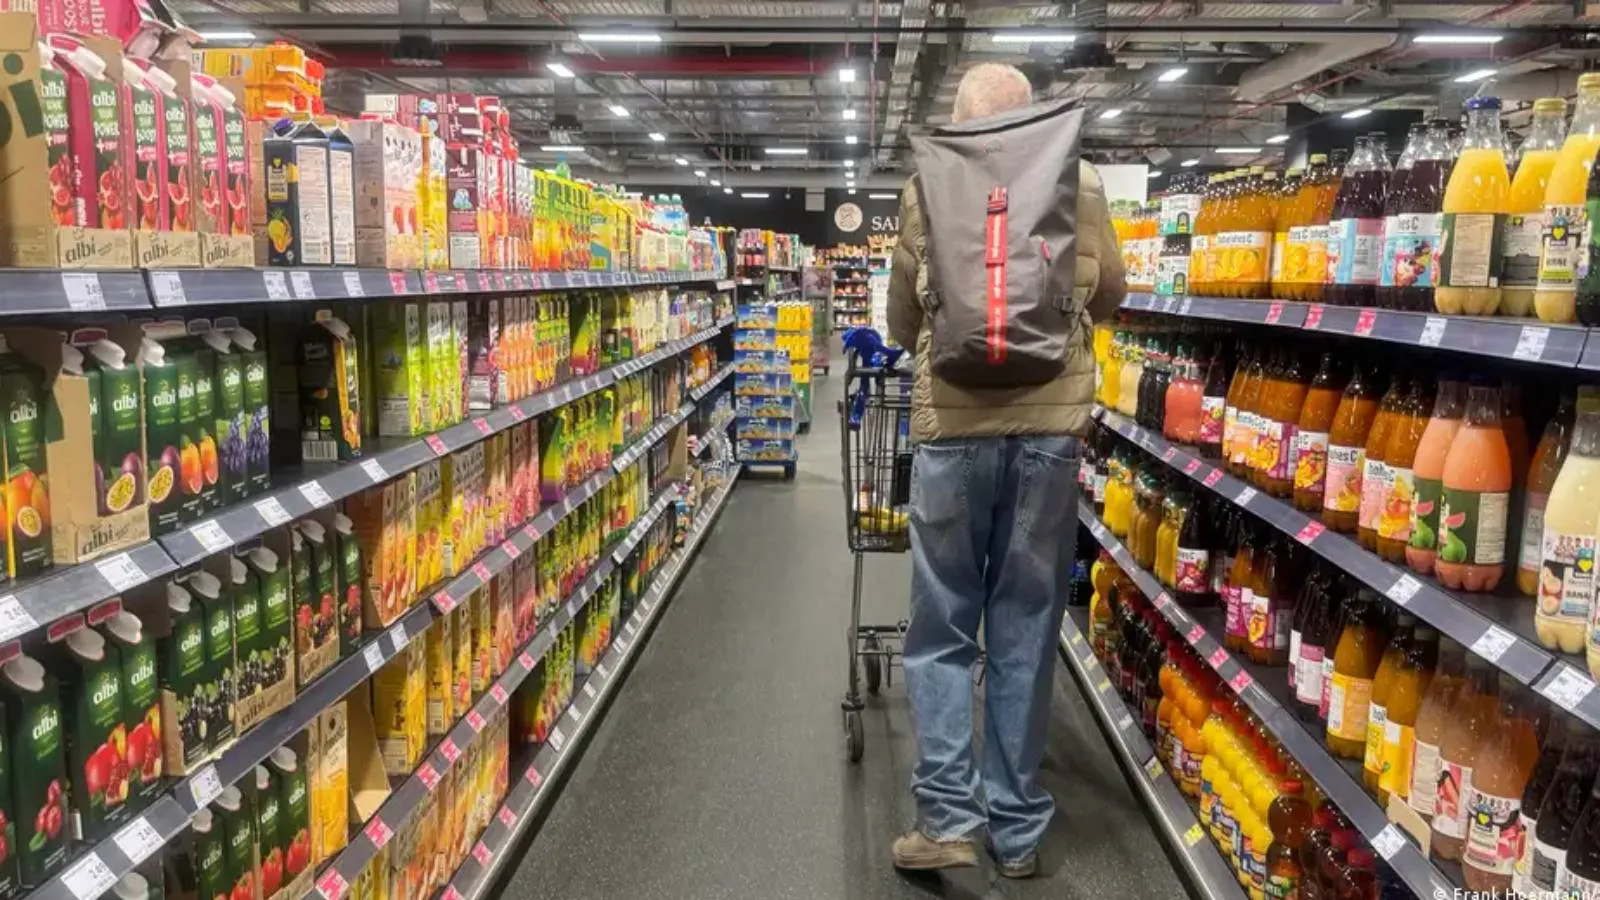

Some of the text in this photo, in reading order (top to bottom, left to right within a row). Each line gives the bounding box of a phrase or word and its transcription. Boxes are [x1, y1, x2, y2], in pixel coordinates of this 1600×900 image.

[93, 90, 116, 106] albi
[65, 237, 96, 264] albi
[143, 240, 169, 265] albi
[206, 242, 230, 264] albi
[247, 364, 264, 382] albi
[113, 392, 137, 412] albi
[153, 388, 176, 408] albi
[10, 404, 37, 424] albi
[83, 526, 113, 558] albi
[267, 590, 287, 608] albi
[237, 600, 257, 620] albi
[211, 617, 230, 637] albi
[181, 634, 202, 652] albi
[131, 661, 153, 686] albi
[93, 678, 119, 706] albi
[32, 708, 58, 741] albi
[289, 785, 305, 805] albi
[261, 800, 279, 823] albi
